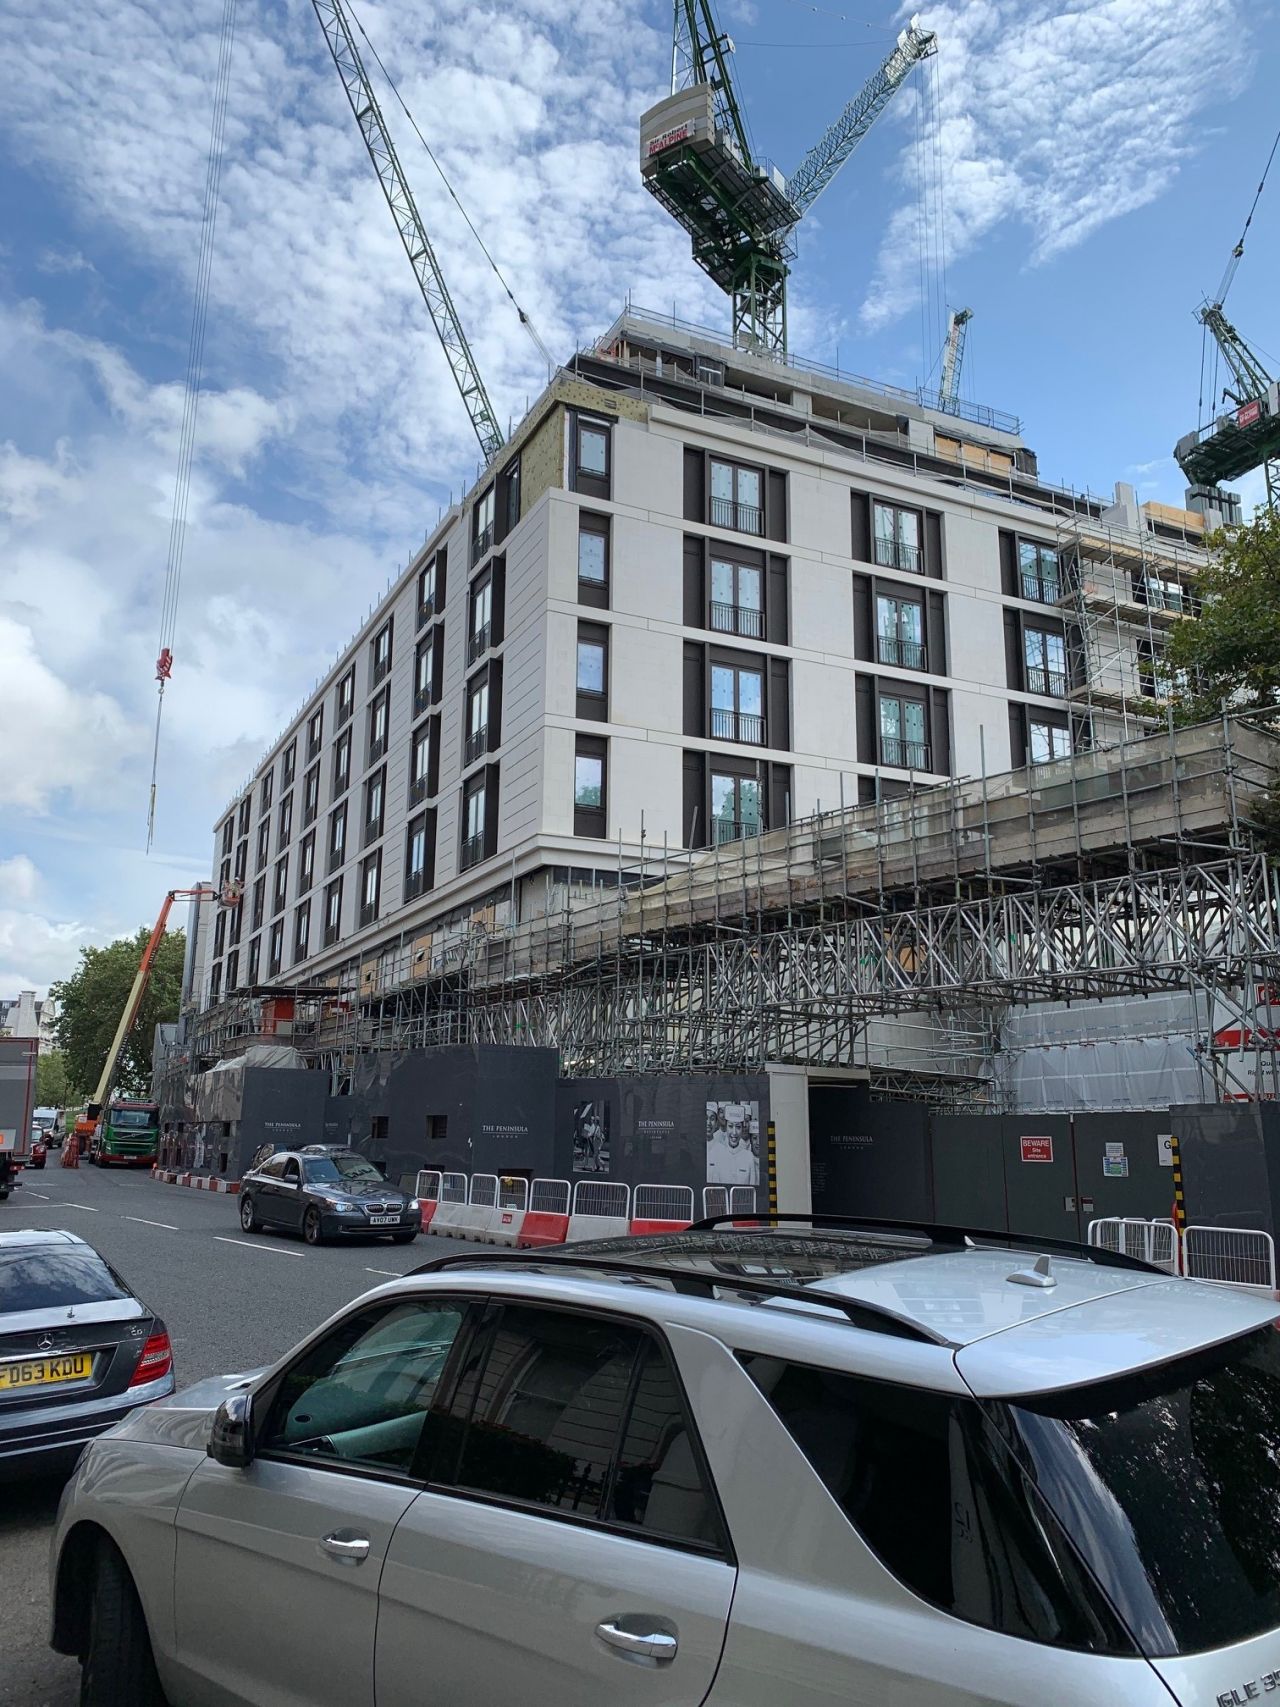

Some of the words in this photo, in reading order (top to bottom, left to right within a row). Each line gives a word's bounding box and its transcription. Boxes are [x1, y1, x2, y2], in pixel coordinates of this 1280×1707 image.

[1023, 1139, 1050, 1147] BEWARE
[50, 1357, 84, 1378] KDU
[1216, 1680, 1261, 1707] GLE
